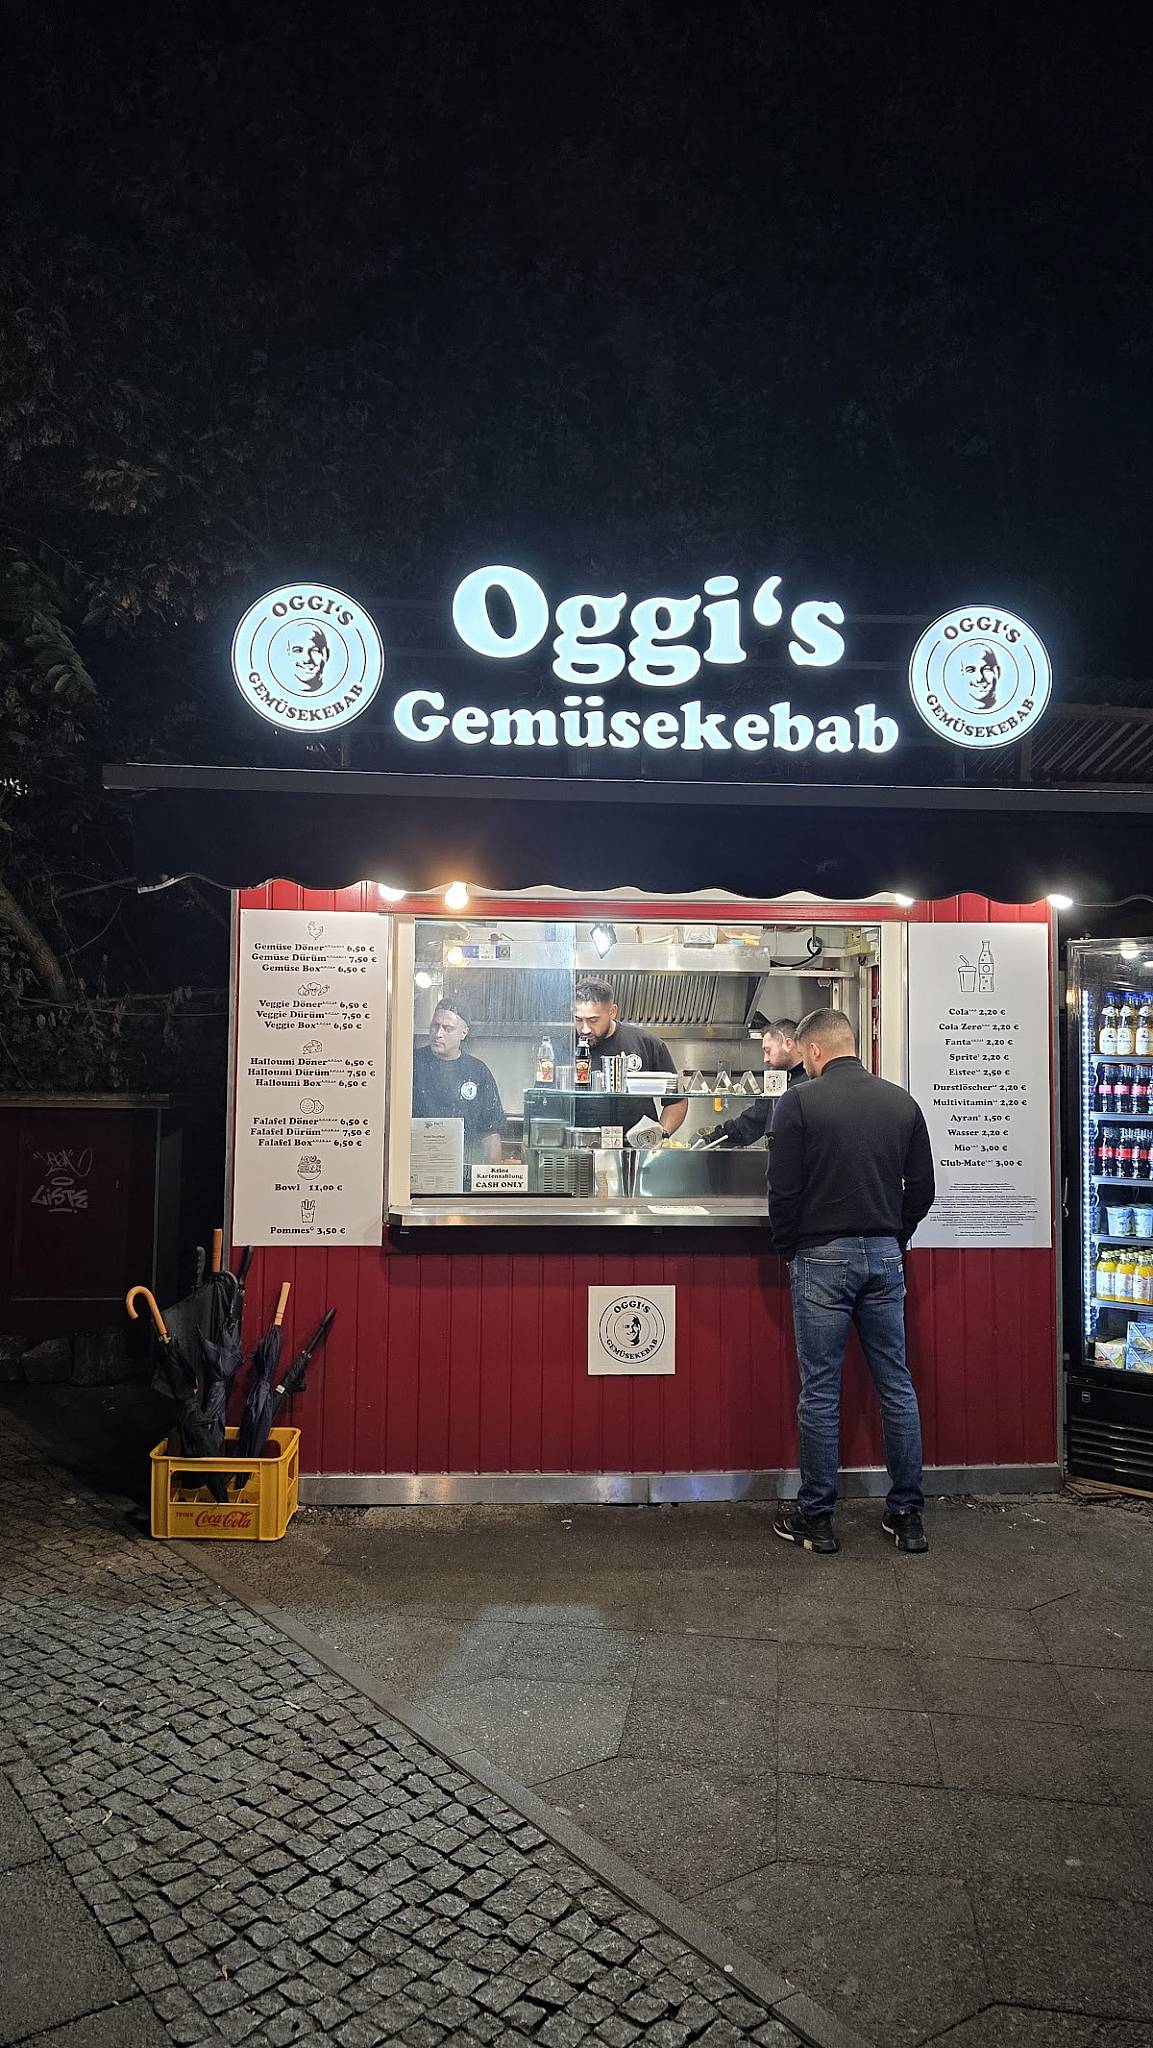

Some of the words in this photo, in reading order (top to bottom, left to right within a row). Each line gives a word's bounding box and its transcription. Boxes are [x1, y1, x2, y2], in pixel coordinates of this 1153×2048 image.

[451, 564, 845, 687] Oggi‘s
[248, 671, 363, 722] GEMÜSEKEBAB
[927, 694, 1035, 738] GEMÜSEKEBAB
[393, 690, 899, 753] Gemüsekebab
[254, 943, 292, 951] Gemüse
[346, 945, 366, 953] 6,50
[251, 953, 289, 961] Gemüse
[349, 956, 368, 964] 7,50
[262, 964, 300, 972] Gemüse
[338, 966, 357, 974] 6,50
[259, 1000, 290, 1009] Veggie
[339, 1002, 359, 1010] 6,50
[256, 1011, 288, 1019] Veggie
[264, 1021, 295, 1030] Veggie
[250, 1058, 295, 1066] Halloumi
[345, 1059, 364, 1067] 6,50
[982, 1054, 1001, 1062] 2,20
[338, 1080, 358, 1088] 6,50
[340, 1118, 360, 1126] 6,50
[250, 1128, 284, 1136] Falafel
[342, 1129, 361, 1137] 7,50
[333, 1140, 354, 1148] 6,50
[995, 1160, 1014, 1168] 3,00
[317, 1227, 337, 1235] 3,50
[606, 1339, 658, 1360] GEMÜSEKEBAB
